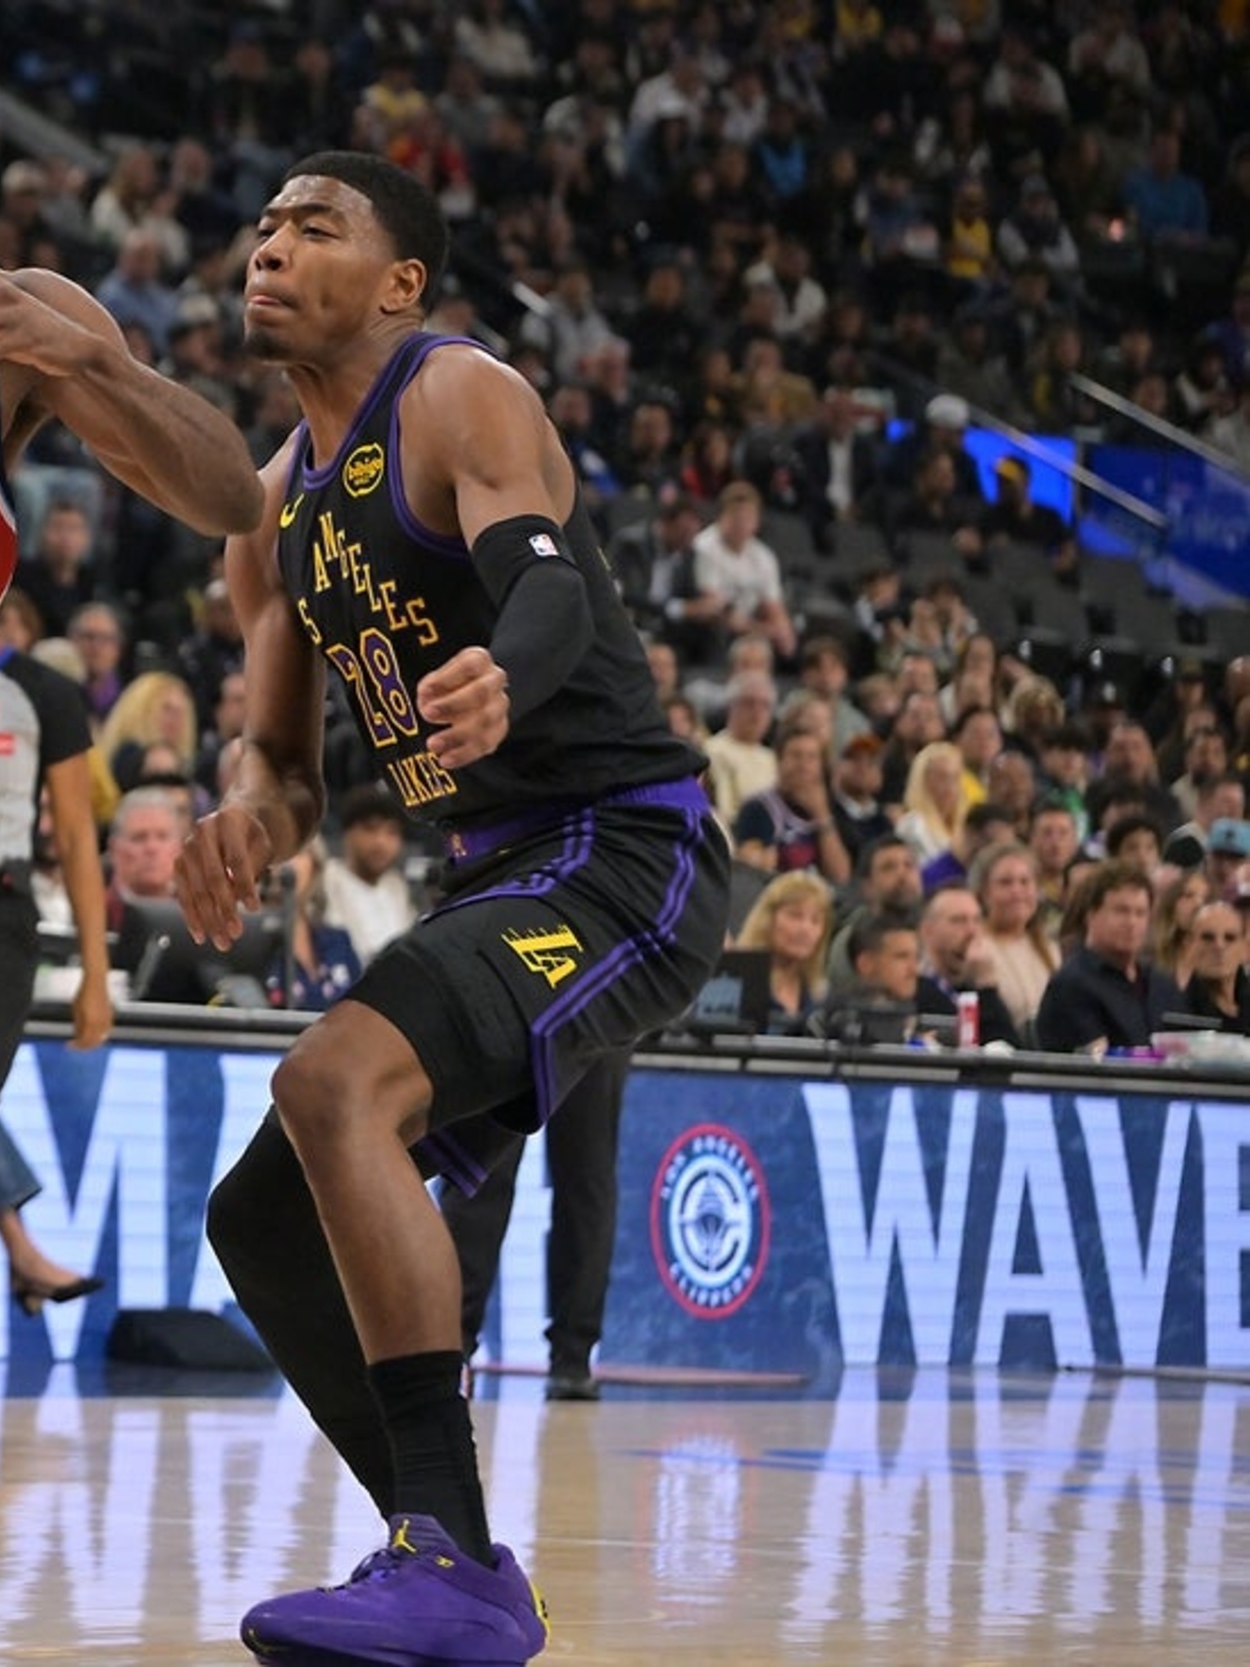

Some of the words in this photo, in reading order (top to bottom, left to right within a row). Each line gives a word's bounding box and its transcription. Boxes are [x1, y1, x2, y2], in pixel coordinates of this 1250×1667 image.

[313, 511, 440, 646] ANGELES
[326, 627, 418, 747] 28
[801, 1083, 1250, 1369] WAVE
